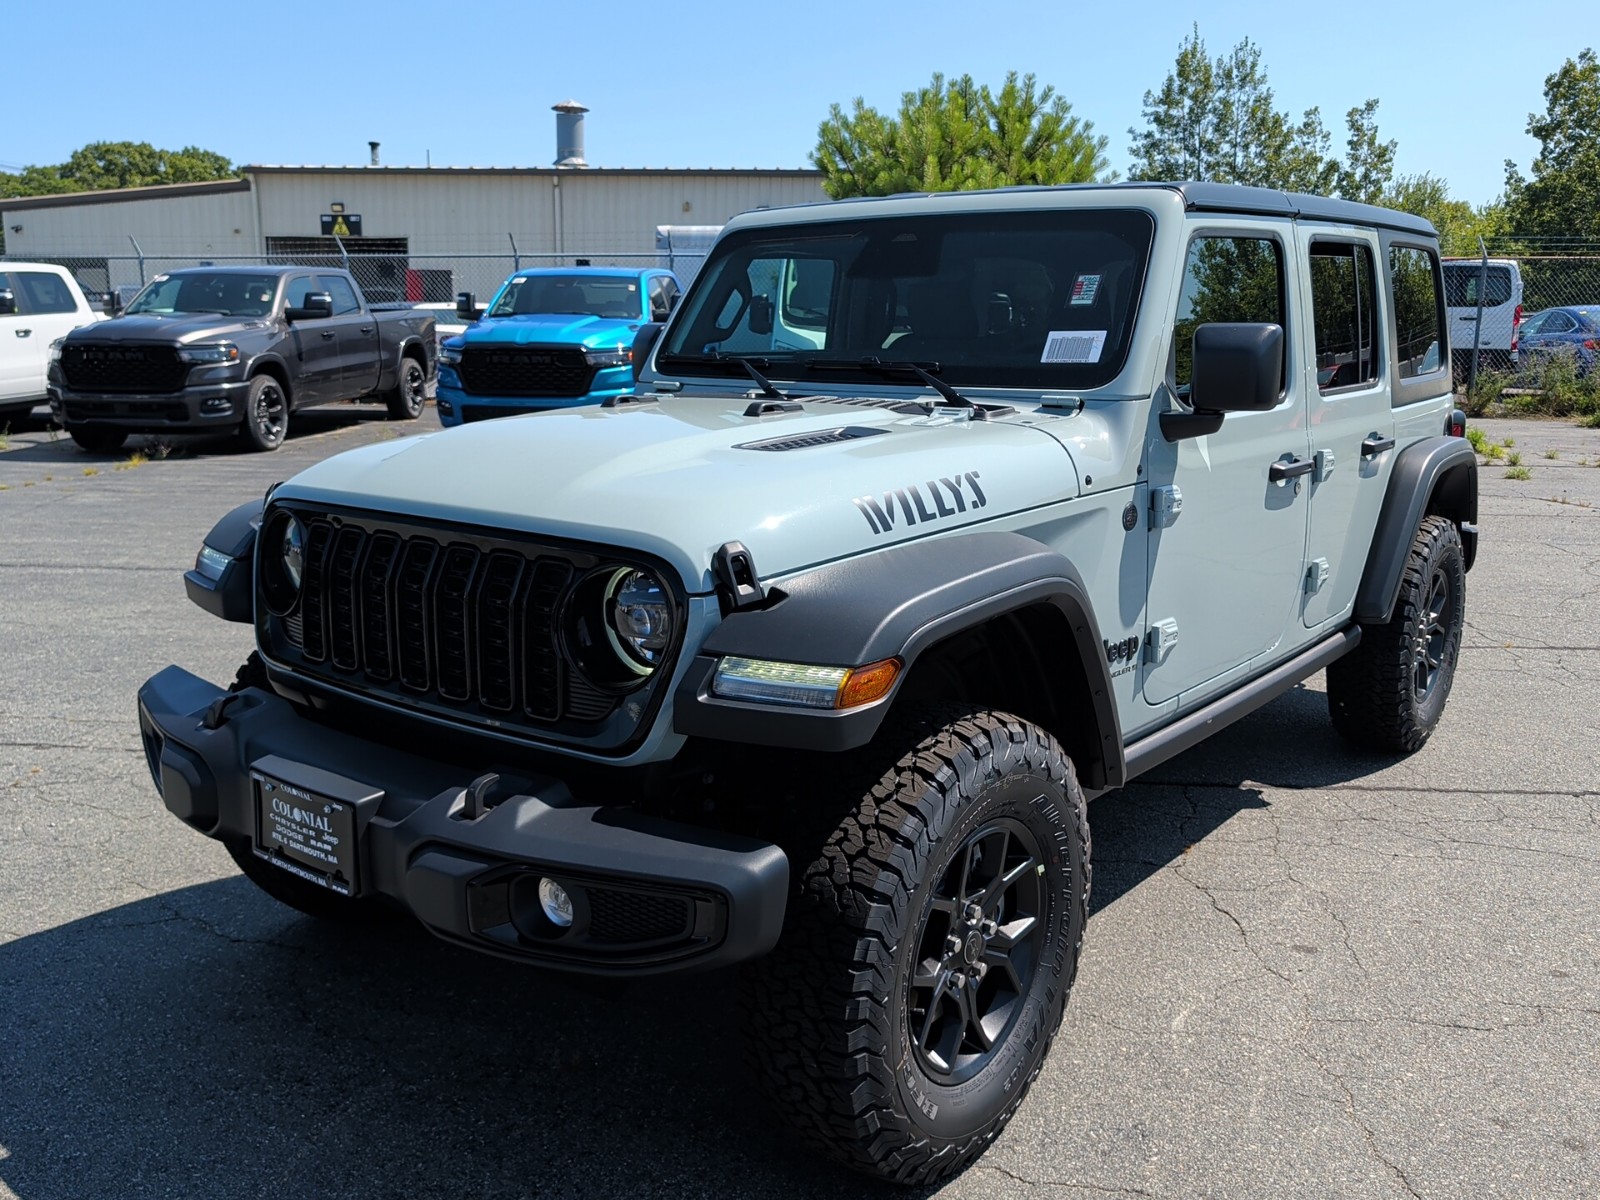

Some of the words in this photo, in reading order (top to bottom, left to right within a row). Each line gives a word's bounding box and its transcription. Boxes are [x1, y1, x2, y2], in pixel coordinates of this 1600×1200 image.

[852, 471, 987, 535] WILLYS
[280, 783, 313, 802] COLONIAL
[270, 812, 316, 837] CHRYSLER
[322, 832, 339, 845] Jeep
[272, 798, 332, 833] COLONIAL
[275, 823, 304, 842] DODGE
[310, 838, 332, 852] RAM
[289, 839, 327, 861] DARTMOUTH,
[327, 854, 338, 864] MA
